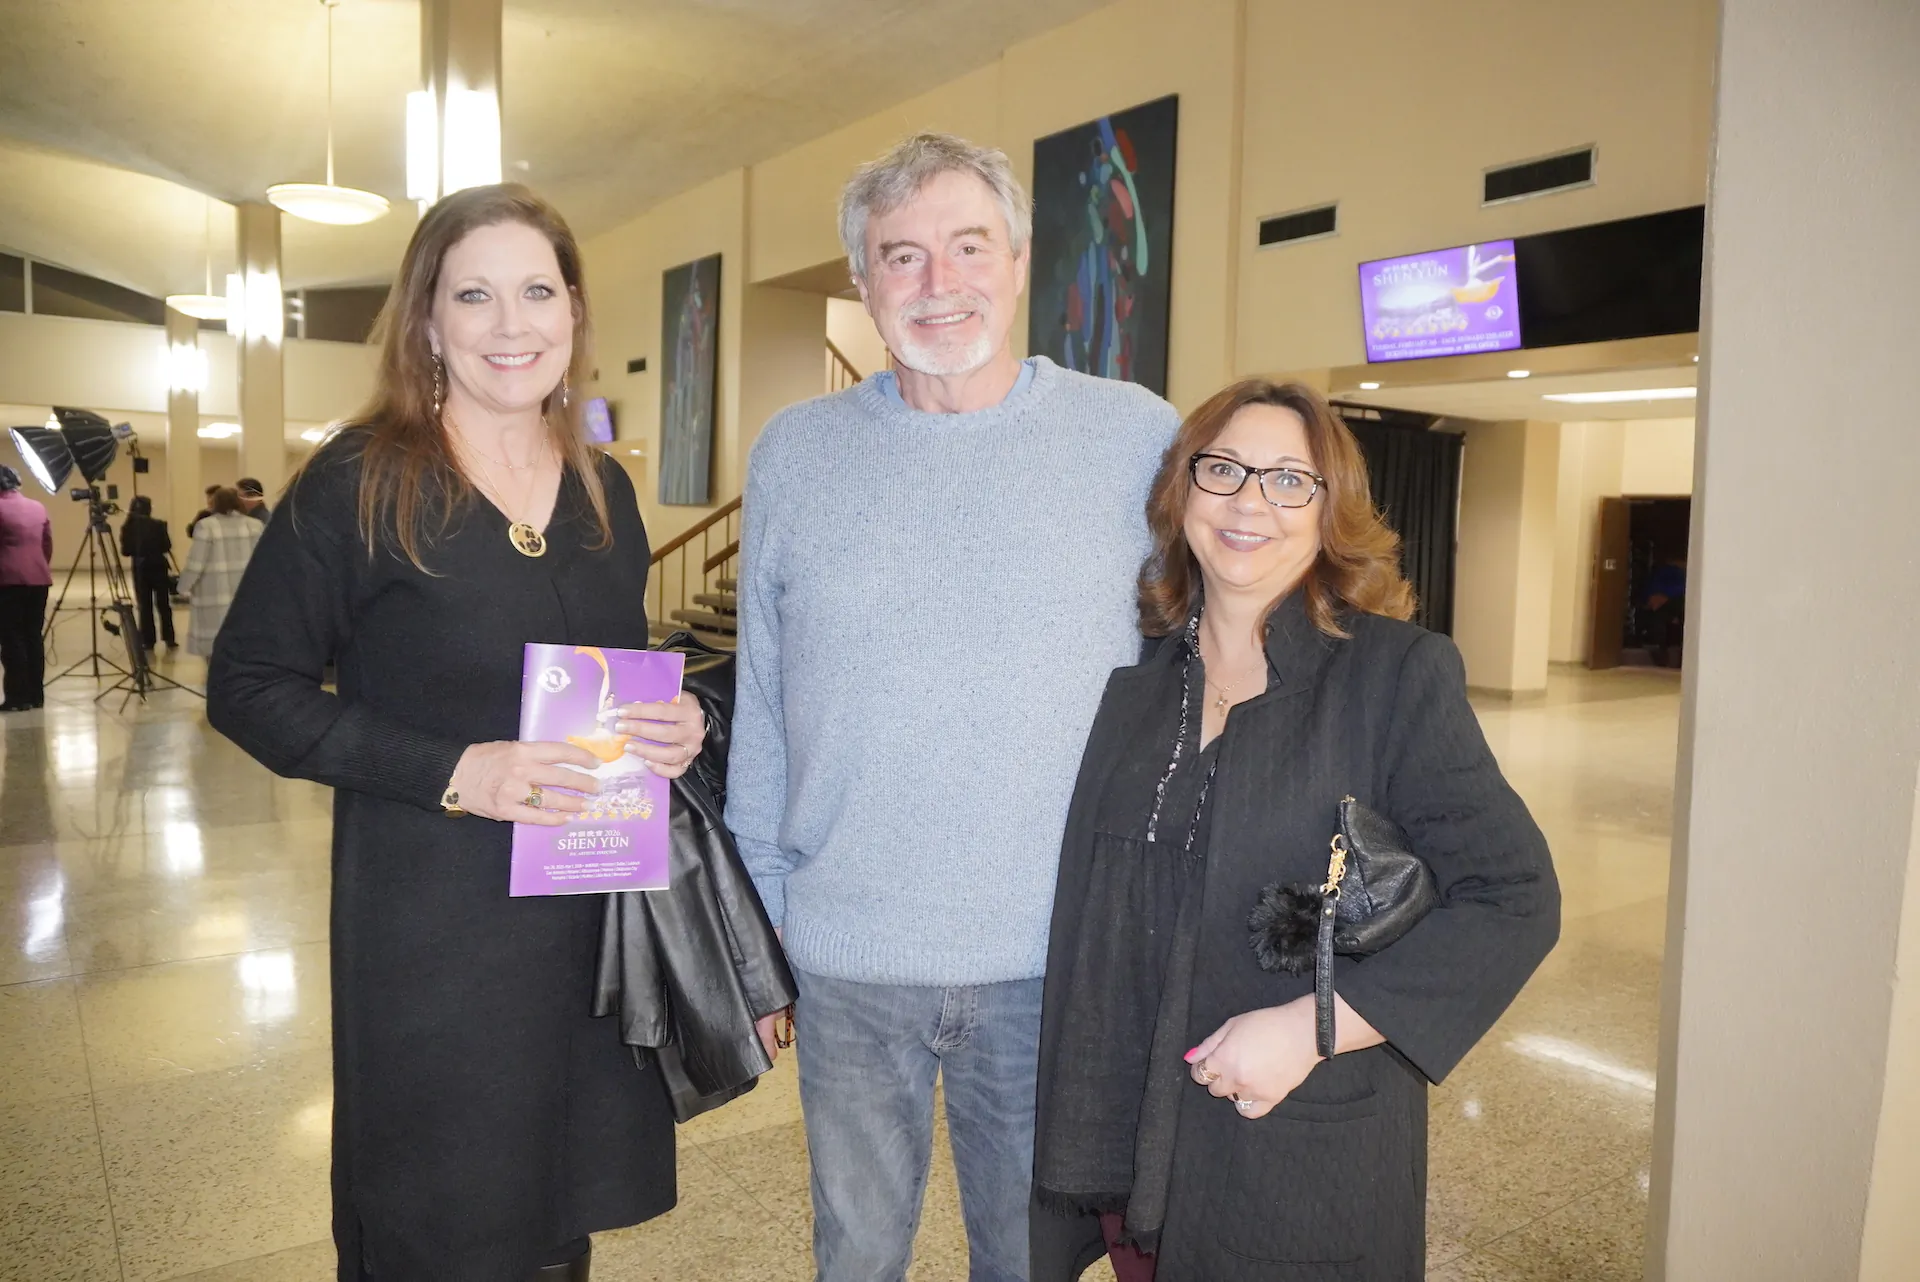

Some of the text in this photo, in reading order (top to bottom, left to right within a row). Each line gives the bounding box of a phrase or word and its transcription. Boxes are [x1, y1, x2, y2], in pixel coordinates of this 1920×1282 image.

[1373, 270, 1413, 286] SHEN
[1416, 263, 1449, 280] YUN
[604, 829, 621, 837] 2026
[557, 836, 629, 850] SHEN YUN
